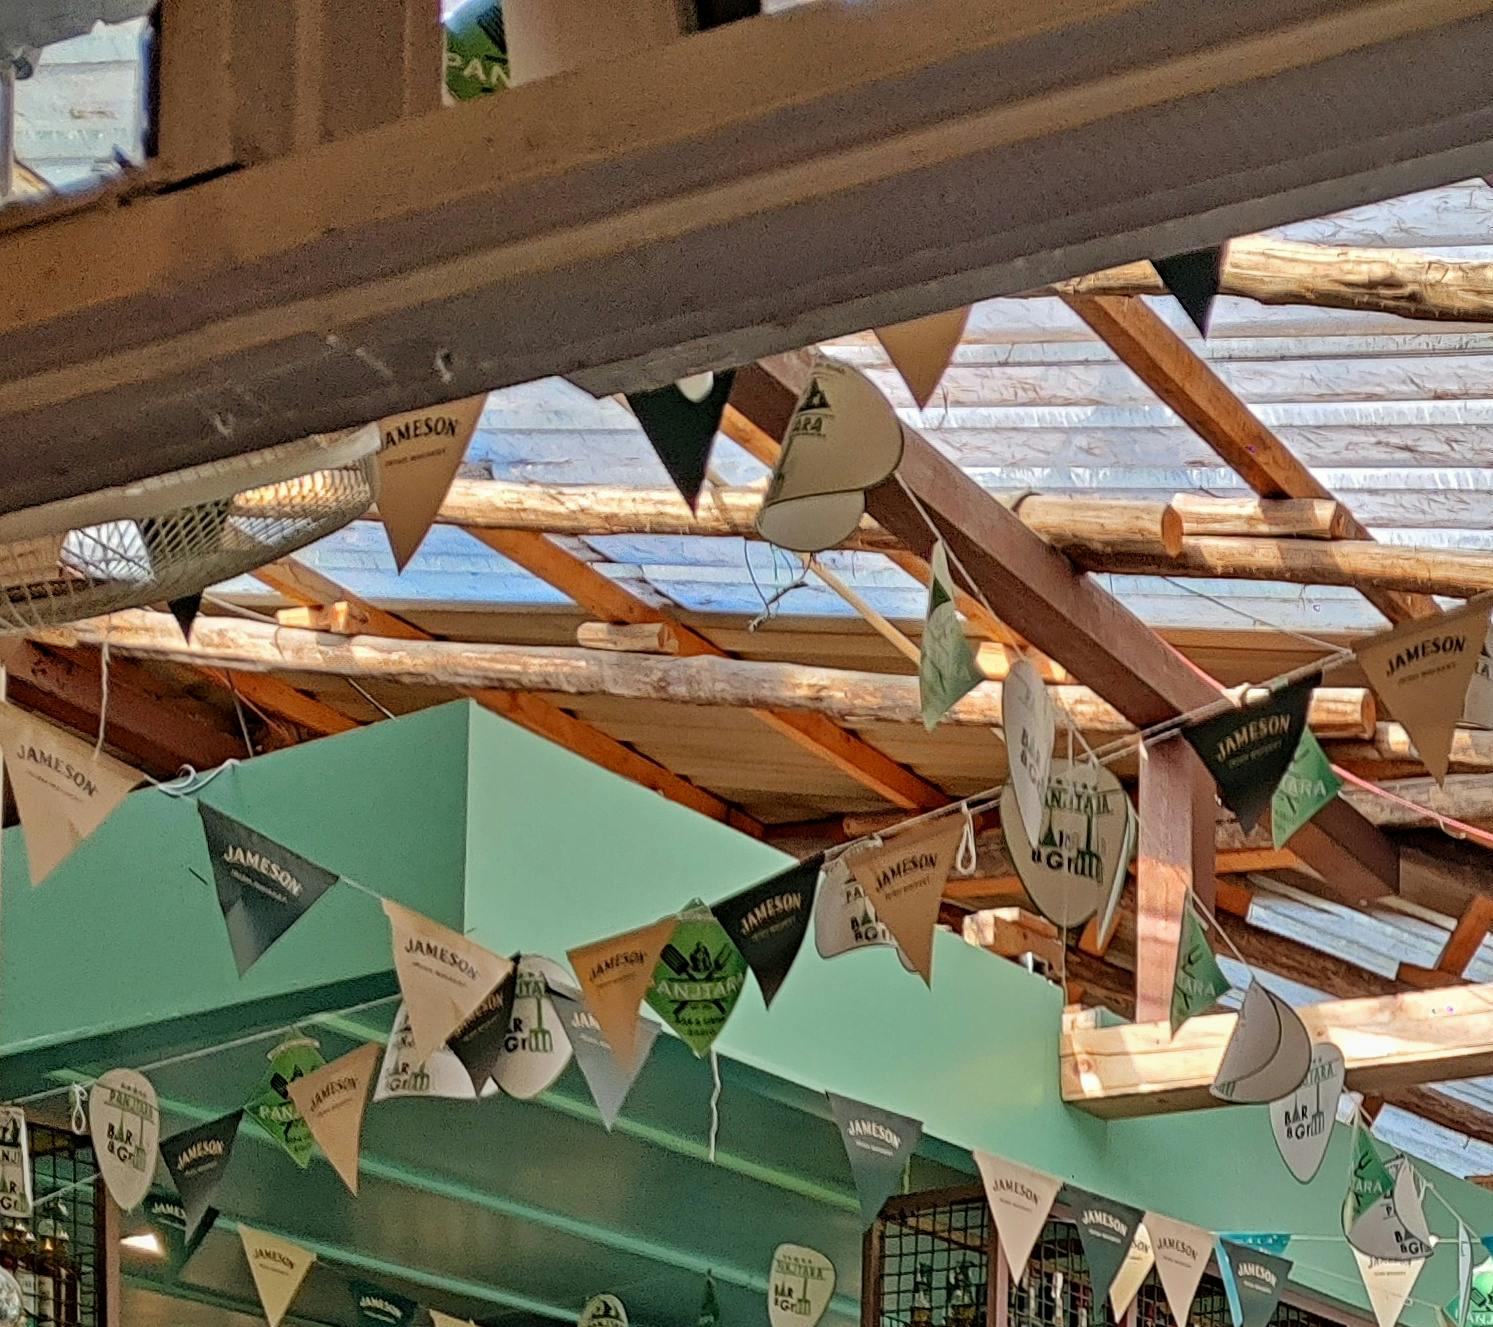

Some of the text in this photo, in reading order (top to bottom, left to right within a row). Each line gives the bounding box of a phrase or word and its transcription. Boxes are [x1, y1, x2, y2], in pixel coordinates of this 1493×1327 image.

[1386, 635, 1466, 677] JAMESON
[1217, 714, 1292, 762] JAMESON
[17, 744, 98, 799] JAMESON
[223, 845, 303, 896] JAMESON
[876, 852, 938, 892] JAMESON
[740, 892, 805, 935] JAMESON
[404, 938, 479, 982] JAMESON
[589, 950, 647, 983] JAMESON
[311, 1077, 359, 1111] JAMESON
[848, 1119, 902, 1150] JAMESON
[177, 1139, 226, 1172] JAMESON
[993, 1179, 1040, 1205] JAMESON
[1082, 1209, 1128, 1238] JAMESON
[254, 1248, 296, 1271] JAMESON
[1157, 1236, 1198, 1262] JAMESON
[1237, 1262, 1278, 1288] JAMESON
